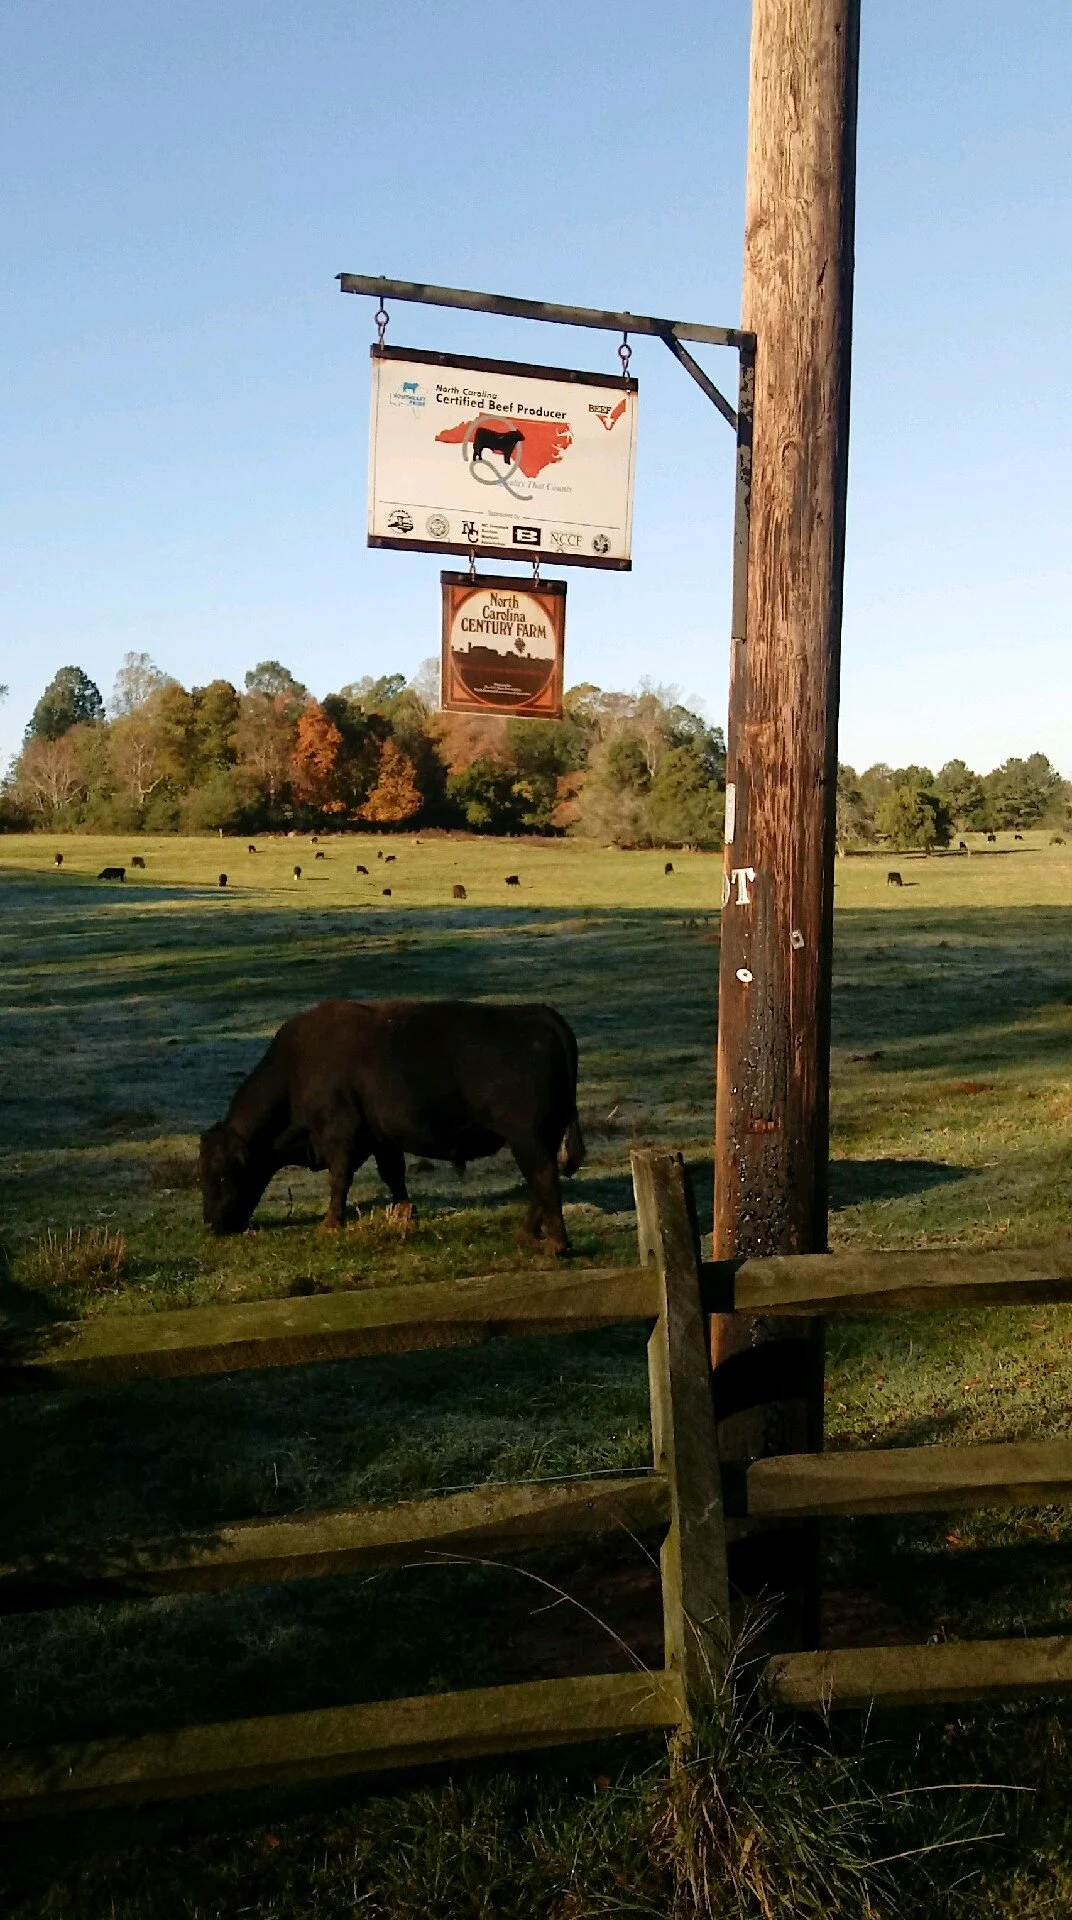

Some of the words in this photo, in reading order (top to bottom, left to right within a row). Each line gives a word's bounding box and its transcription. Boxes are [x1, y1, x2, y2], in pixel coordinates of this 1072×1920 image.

[435, 384, 460, 395] North
[463, 388, 498, 400] Carolina
[436, 394, 485, 409] Certified
[489, 400, 514, 413] Beef
[517, 404, 567, 420] Producer
[588, 404, 612, 415] BEEF
[490, 592, 519, 609] North
[482, 605, 526, 623] Carolina
[461, 617, 514, 637] CENTURY
[516, 622, 547, 639] FARM
